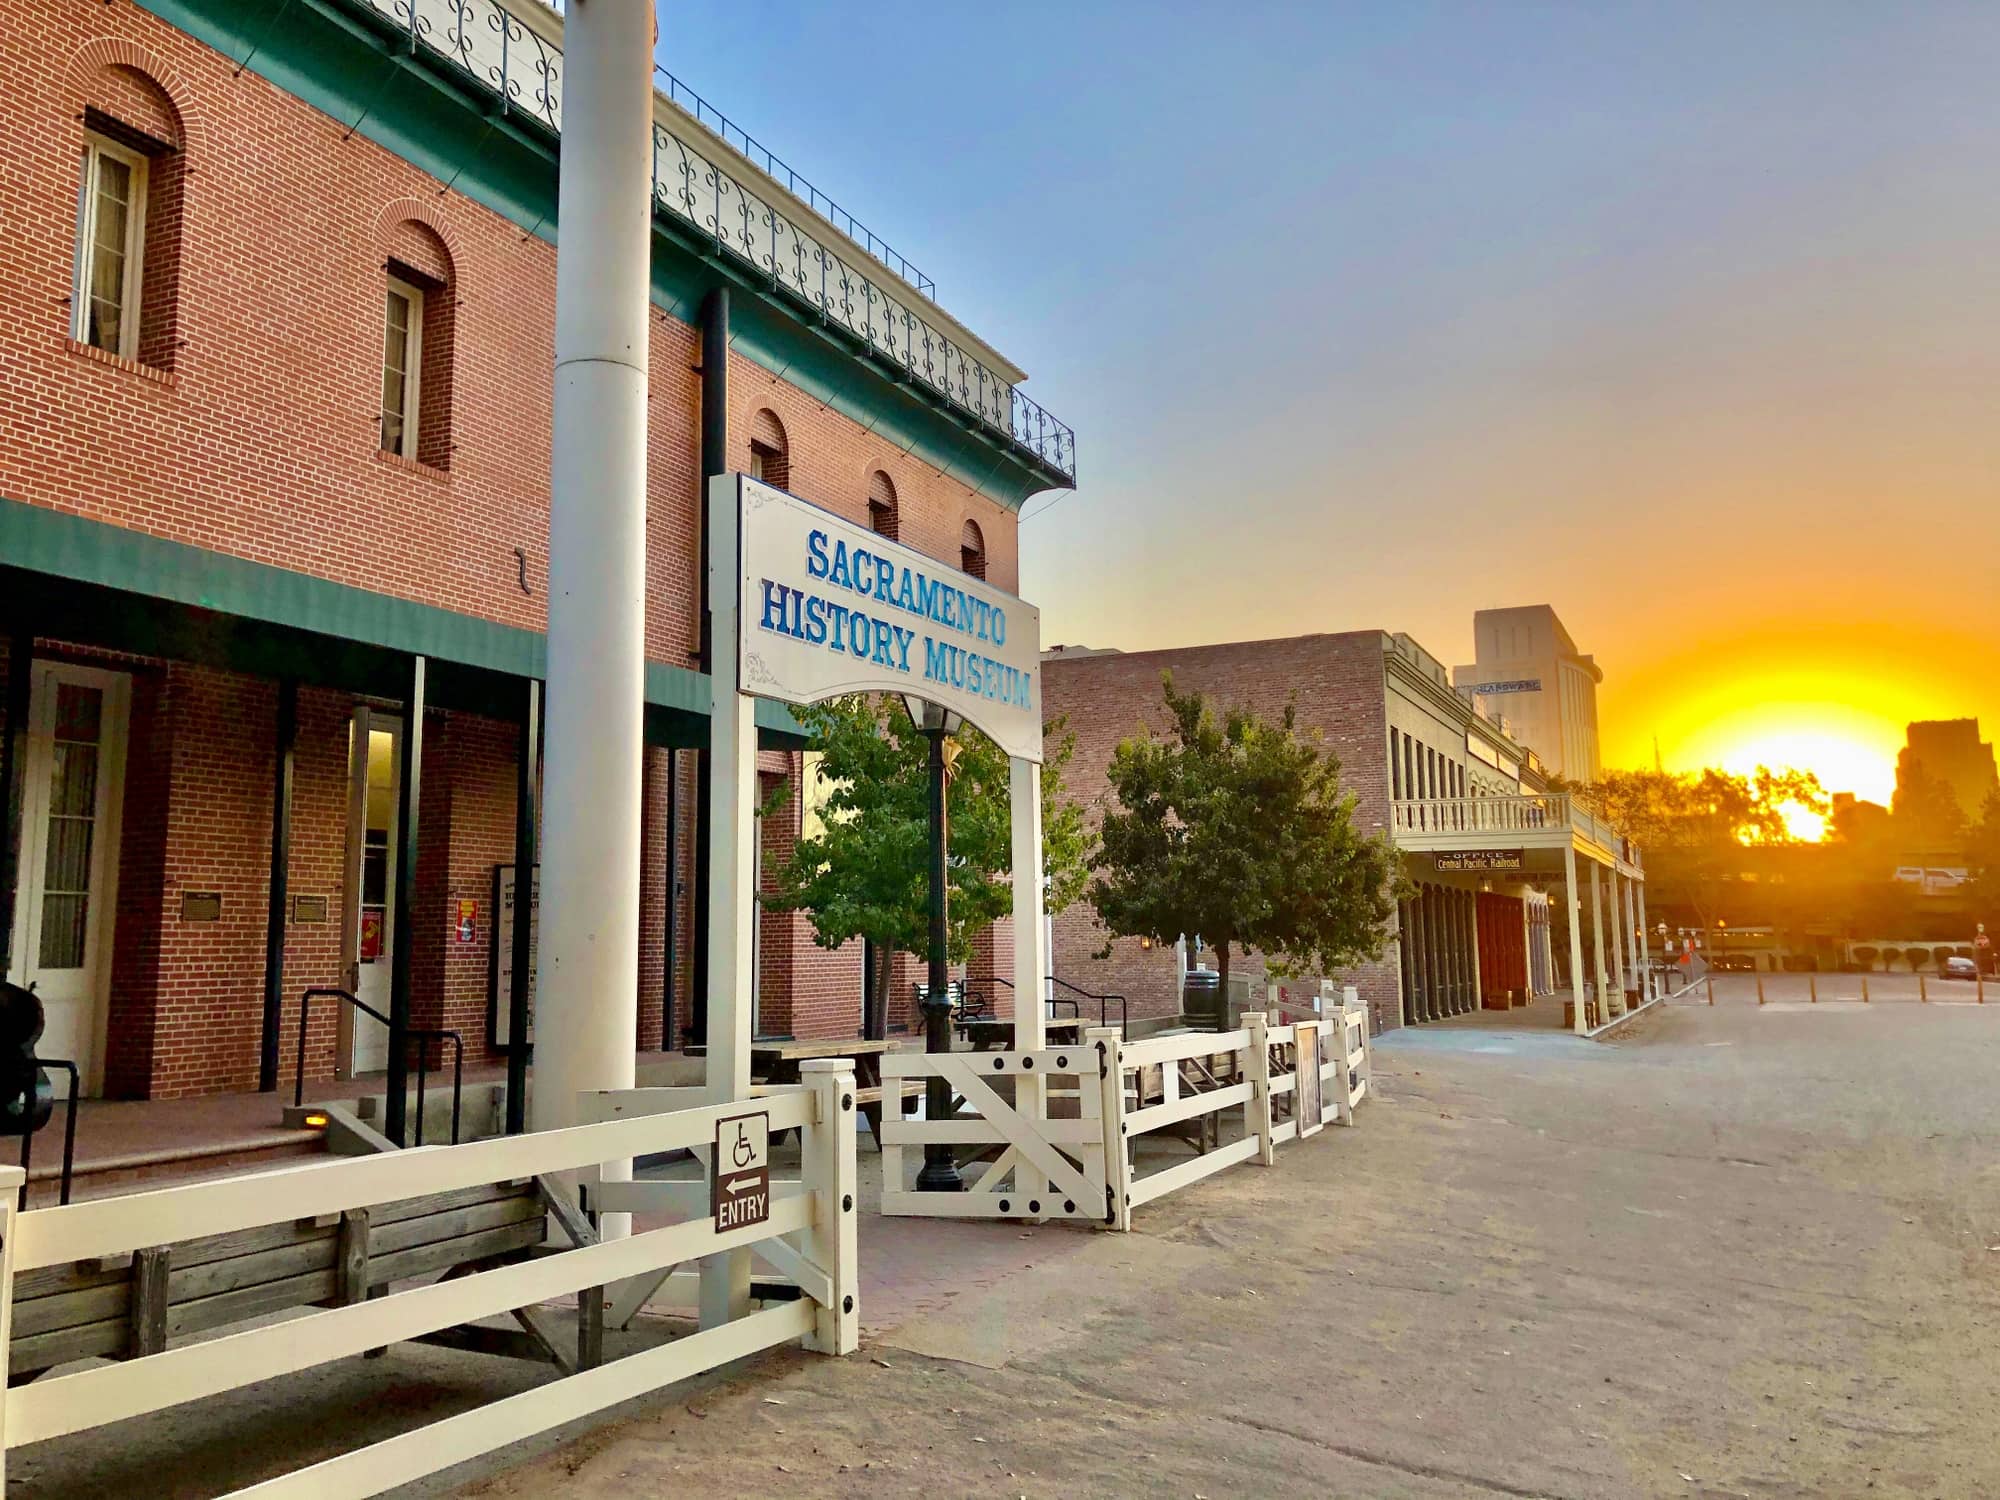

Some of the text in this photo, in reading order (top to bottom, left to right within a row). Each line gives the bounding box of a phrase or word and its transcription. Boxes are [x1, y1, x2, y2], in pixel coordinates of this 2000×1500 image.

[807, 528, 1006, 648] SACRAMENTO
[760, 577, 1032, 711] HISTORY MUSEUM
[1438, 857, 1521, 869] Central Pacific Railroad
[719, 1193, 766, 1227] ENTRY
